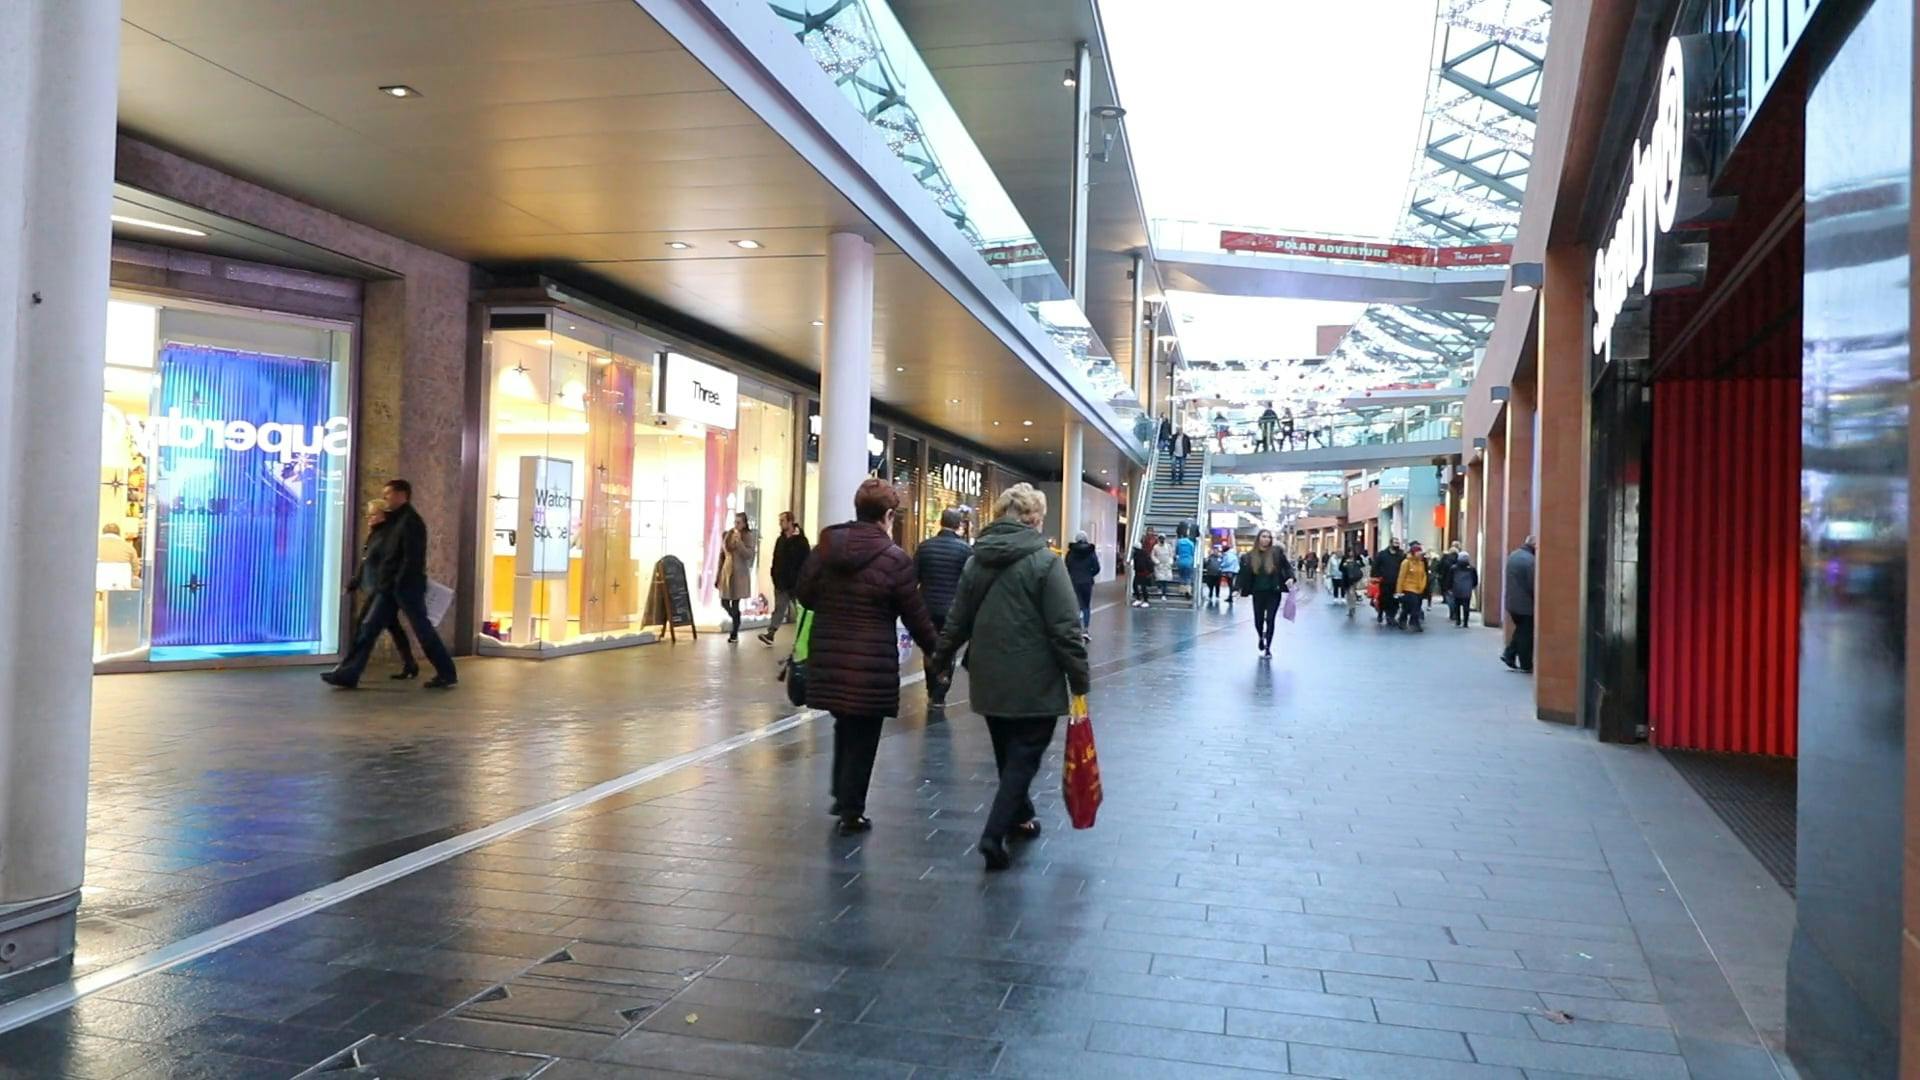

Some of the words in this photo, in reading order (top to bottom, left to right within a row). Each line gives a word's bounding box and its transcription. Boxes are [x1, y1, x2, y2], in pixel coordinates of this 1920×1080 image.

[1276, 240, 1316, 251] POLAR
[1318, 243, 1389, 258] ADVENTURE
[943, 463, 982, 497] OFFICE
[535, 488, 571, 510] Watch
